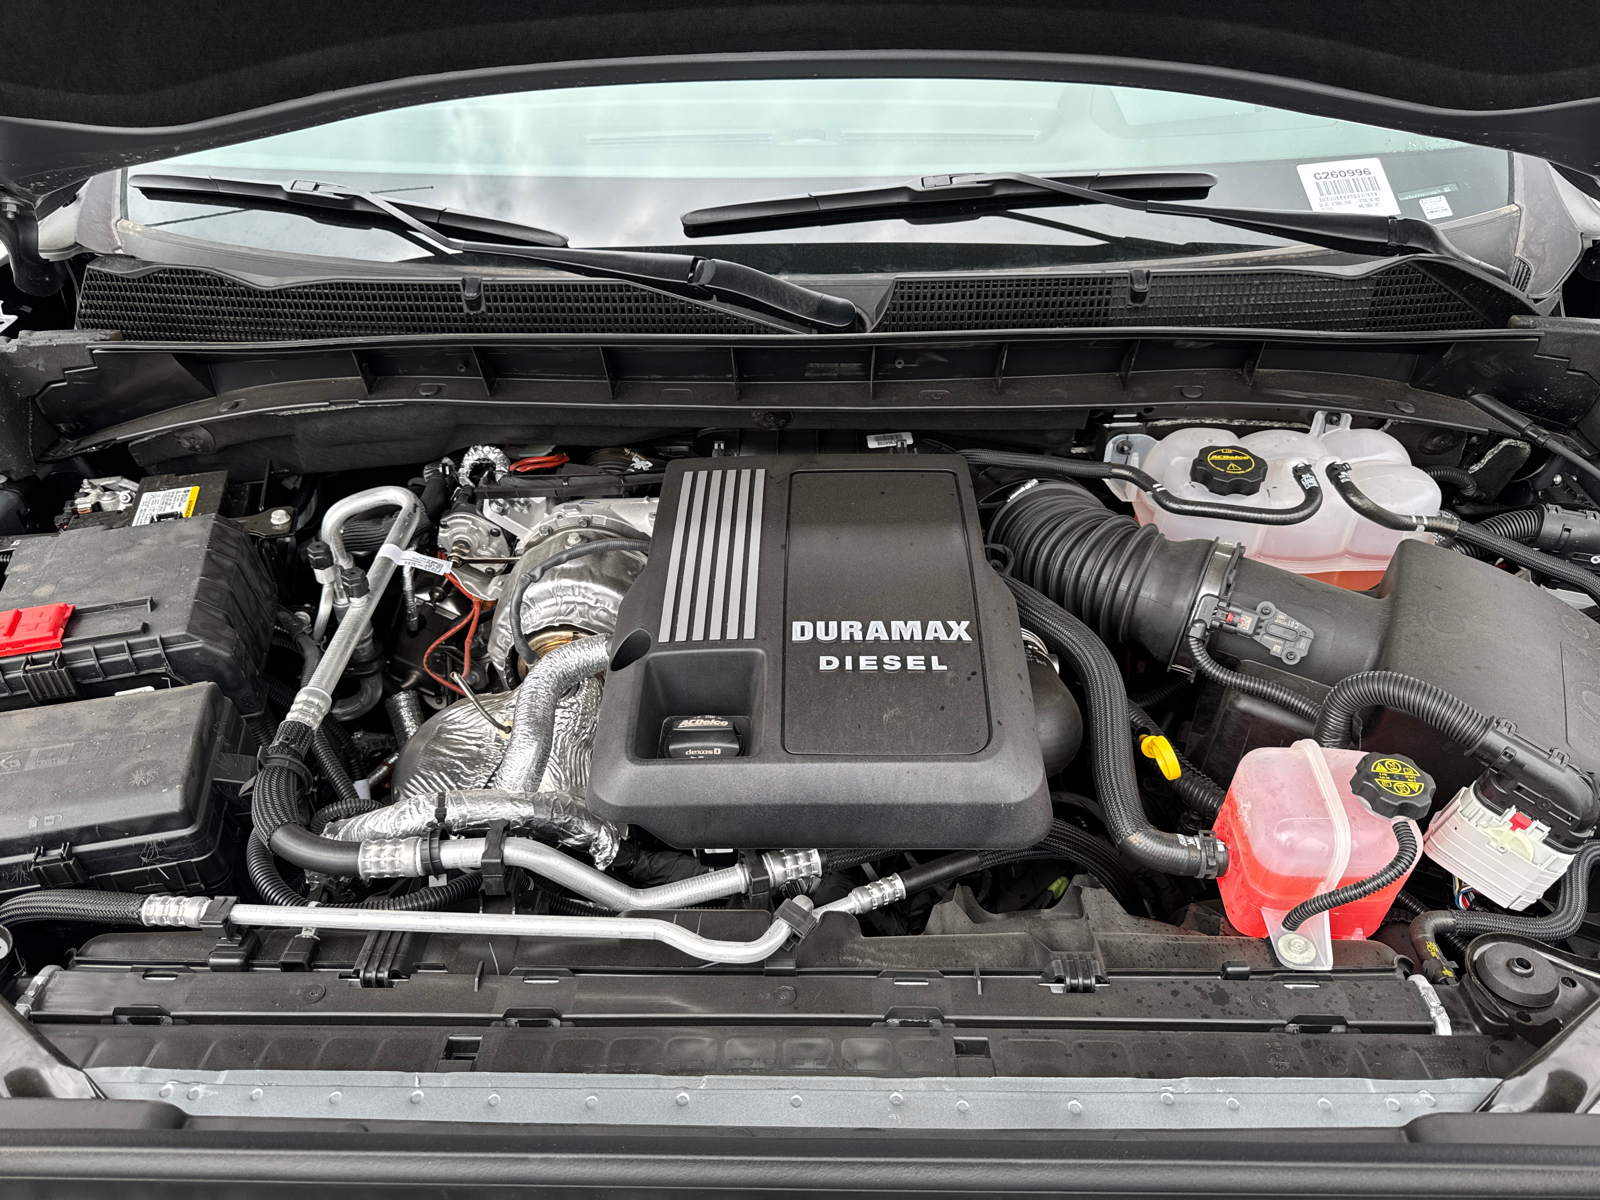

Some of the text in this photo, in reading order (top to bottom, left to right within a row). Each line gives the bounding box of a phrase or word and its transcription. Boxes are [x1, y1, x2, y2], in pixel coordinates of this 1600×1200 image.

[791, 620, 973, 643] DURAMAX
[819, 655, 948, 672] DIESEL
[677, 719, 729, 729] ACDelco
